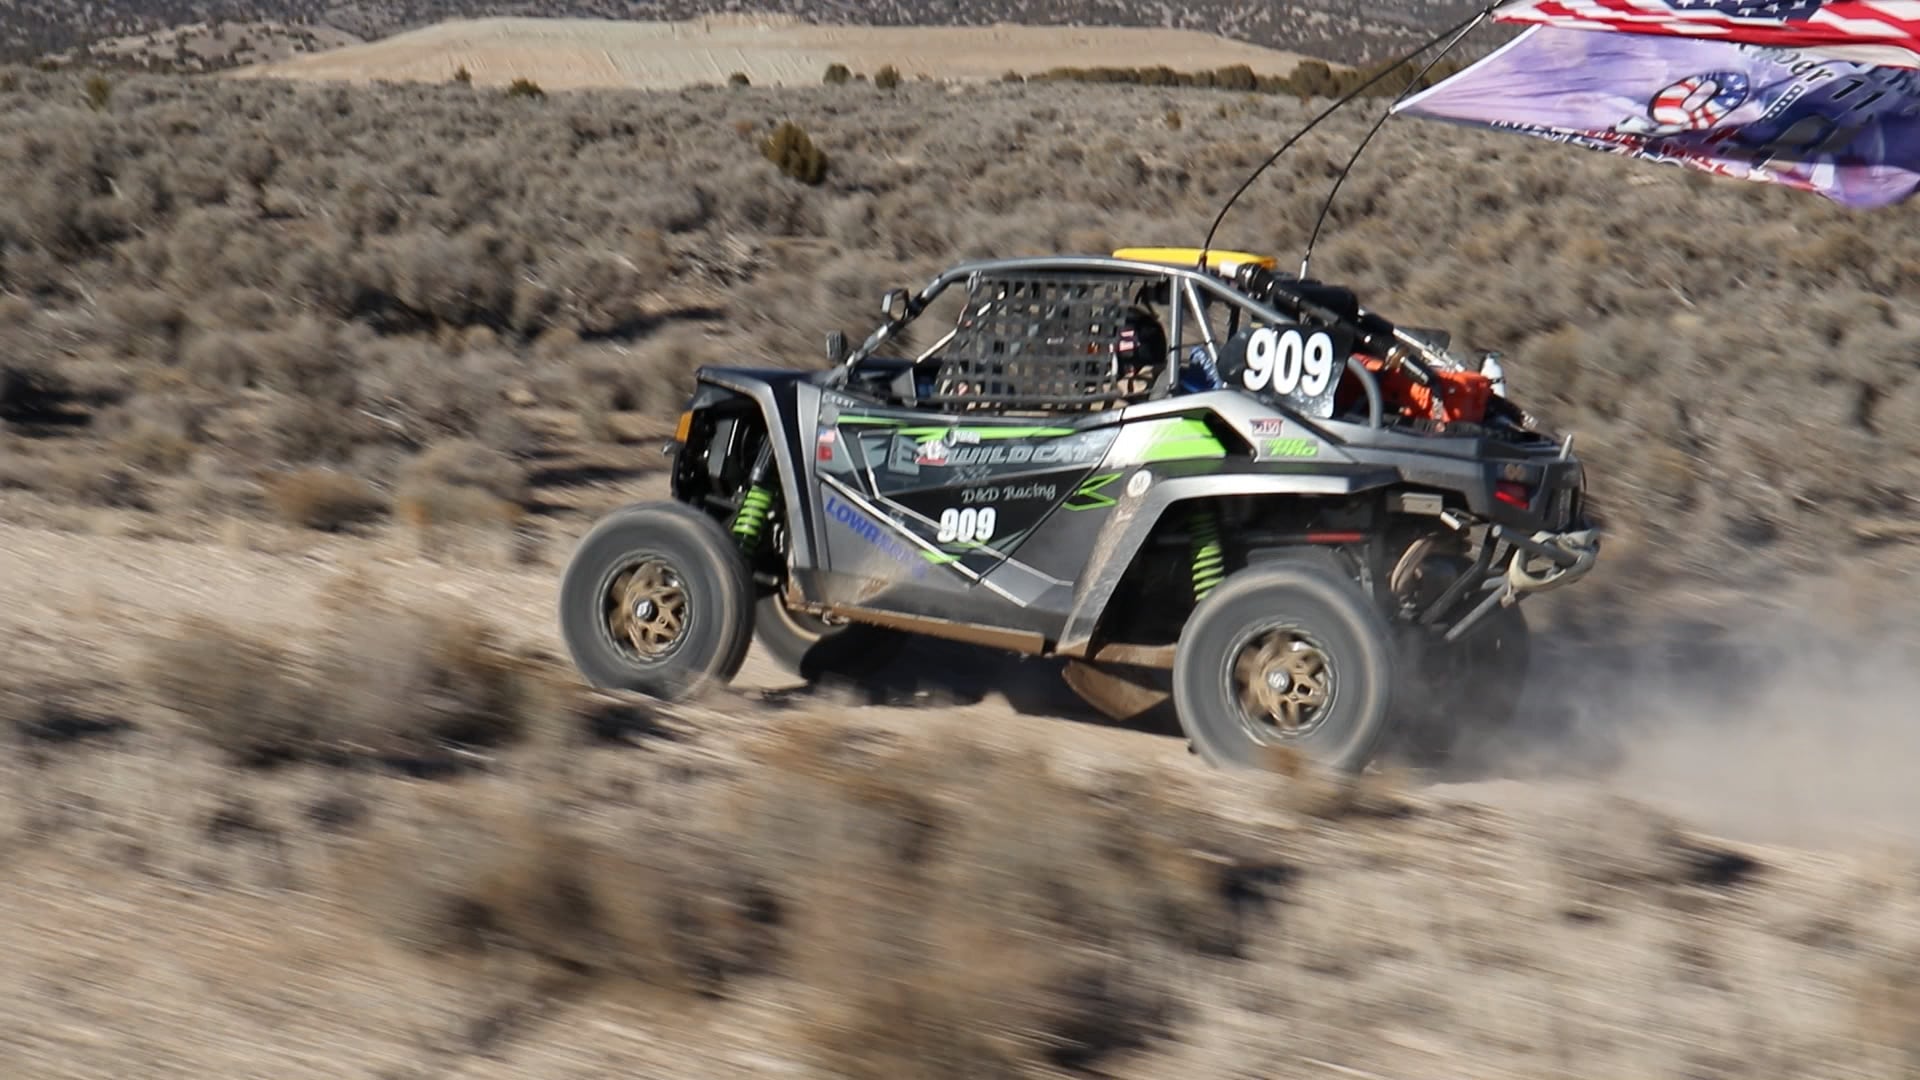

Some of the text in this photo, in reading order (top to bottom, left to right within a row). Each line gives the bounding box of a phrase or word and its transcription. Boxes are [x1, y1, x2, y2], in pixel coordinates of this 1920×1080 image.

[1243, 327, 1334, 396] 909
[945, 443, 1090, 464] WILDCAT
[961, 482, 1057, 504] D&D Racing
[826, 496, 928, 578] LOWRA
[938, 507, 997, 543] 909
